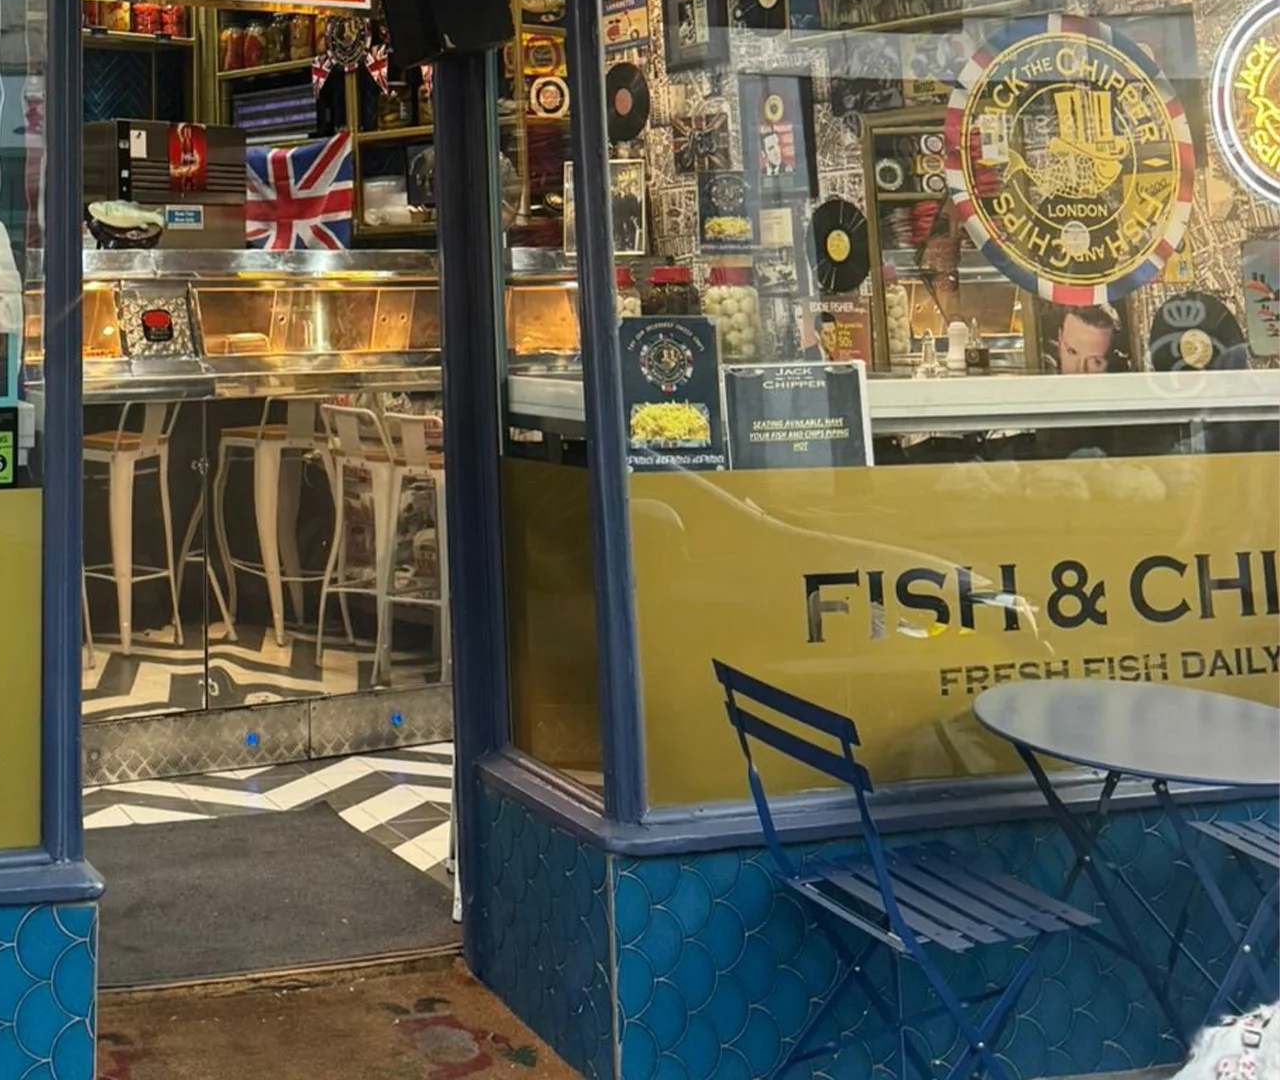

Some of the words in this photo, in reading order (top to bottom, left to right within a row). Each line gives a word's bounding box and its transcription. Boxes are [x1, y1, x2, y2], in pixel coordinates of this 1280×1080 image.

[1021, 57, 1053, 79] THE
[1055, 47, 1160, 144] CHIPPER
[1234, 37, 1278, 100] JACK
[992, 192, 1072, 268] CHIPS
[1047, 204, 1109, 218] LONDON
[1103, 193, 1163, 259] FISH
[762, 380, 827, 390] CHIPPER
[775, 367, 813, 377] JACK
[803, 563, 1021, 643] FISH
[1047, 560, 1108, 629] &
[1084, 652, 1168, 681] FISH
